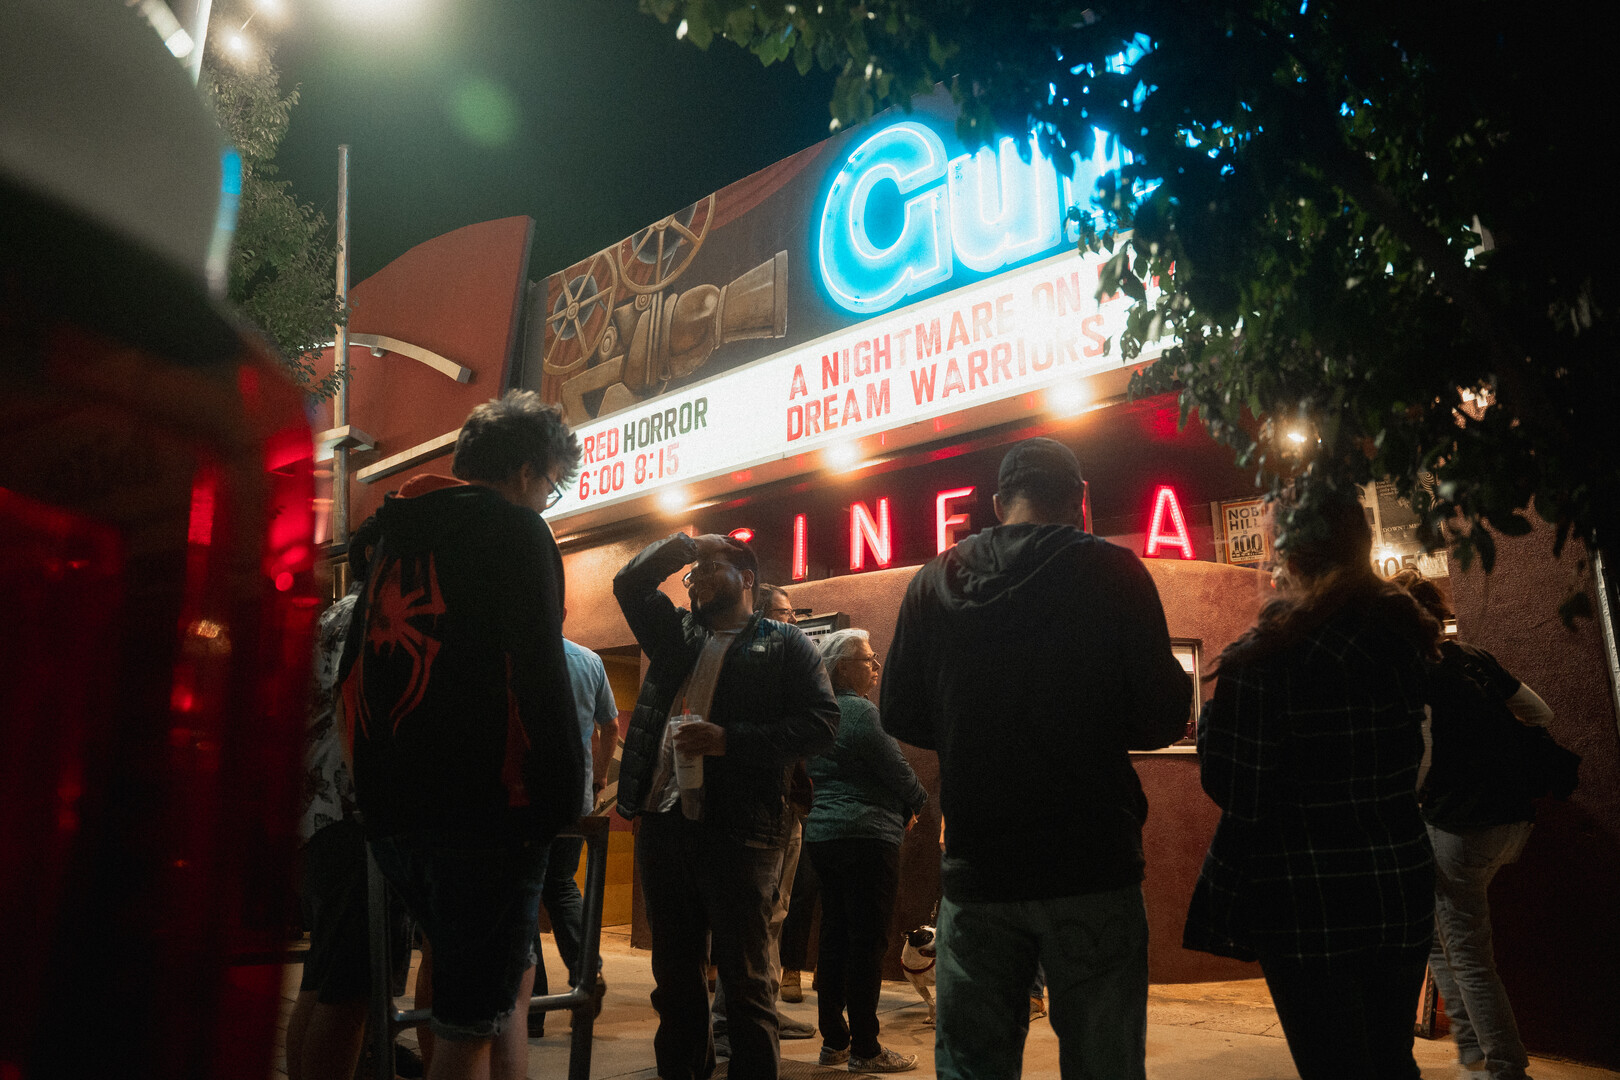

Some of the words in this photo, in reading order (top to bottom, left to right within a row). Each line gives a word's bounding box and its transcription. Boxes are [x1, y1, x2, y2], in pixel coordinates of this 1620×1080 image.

[789, 363, 809, 401] A
[821, 292, 1015, 392] NIGHTMARE
[1031, 271, 1081, 317] ON
[786, 377, 891, 442] DREAM
[910, 313, 1106, 406] WARRIORS
[583, 427, 619, 465] RED
[623, 396, 708, 453] HORROR
[578, 460, 625, 501] 6:00
[634, 441, 680, 485] 8:15
[729, 481, 1197, 581] INEA
[1228, 506, 1260, 520] NOB
[1229, 517, 1261, 531] HILL
[1230, 533, 1263, 553] 100
